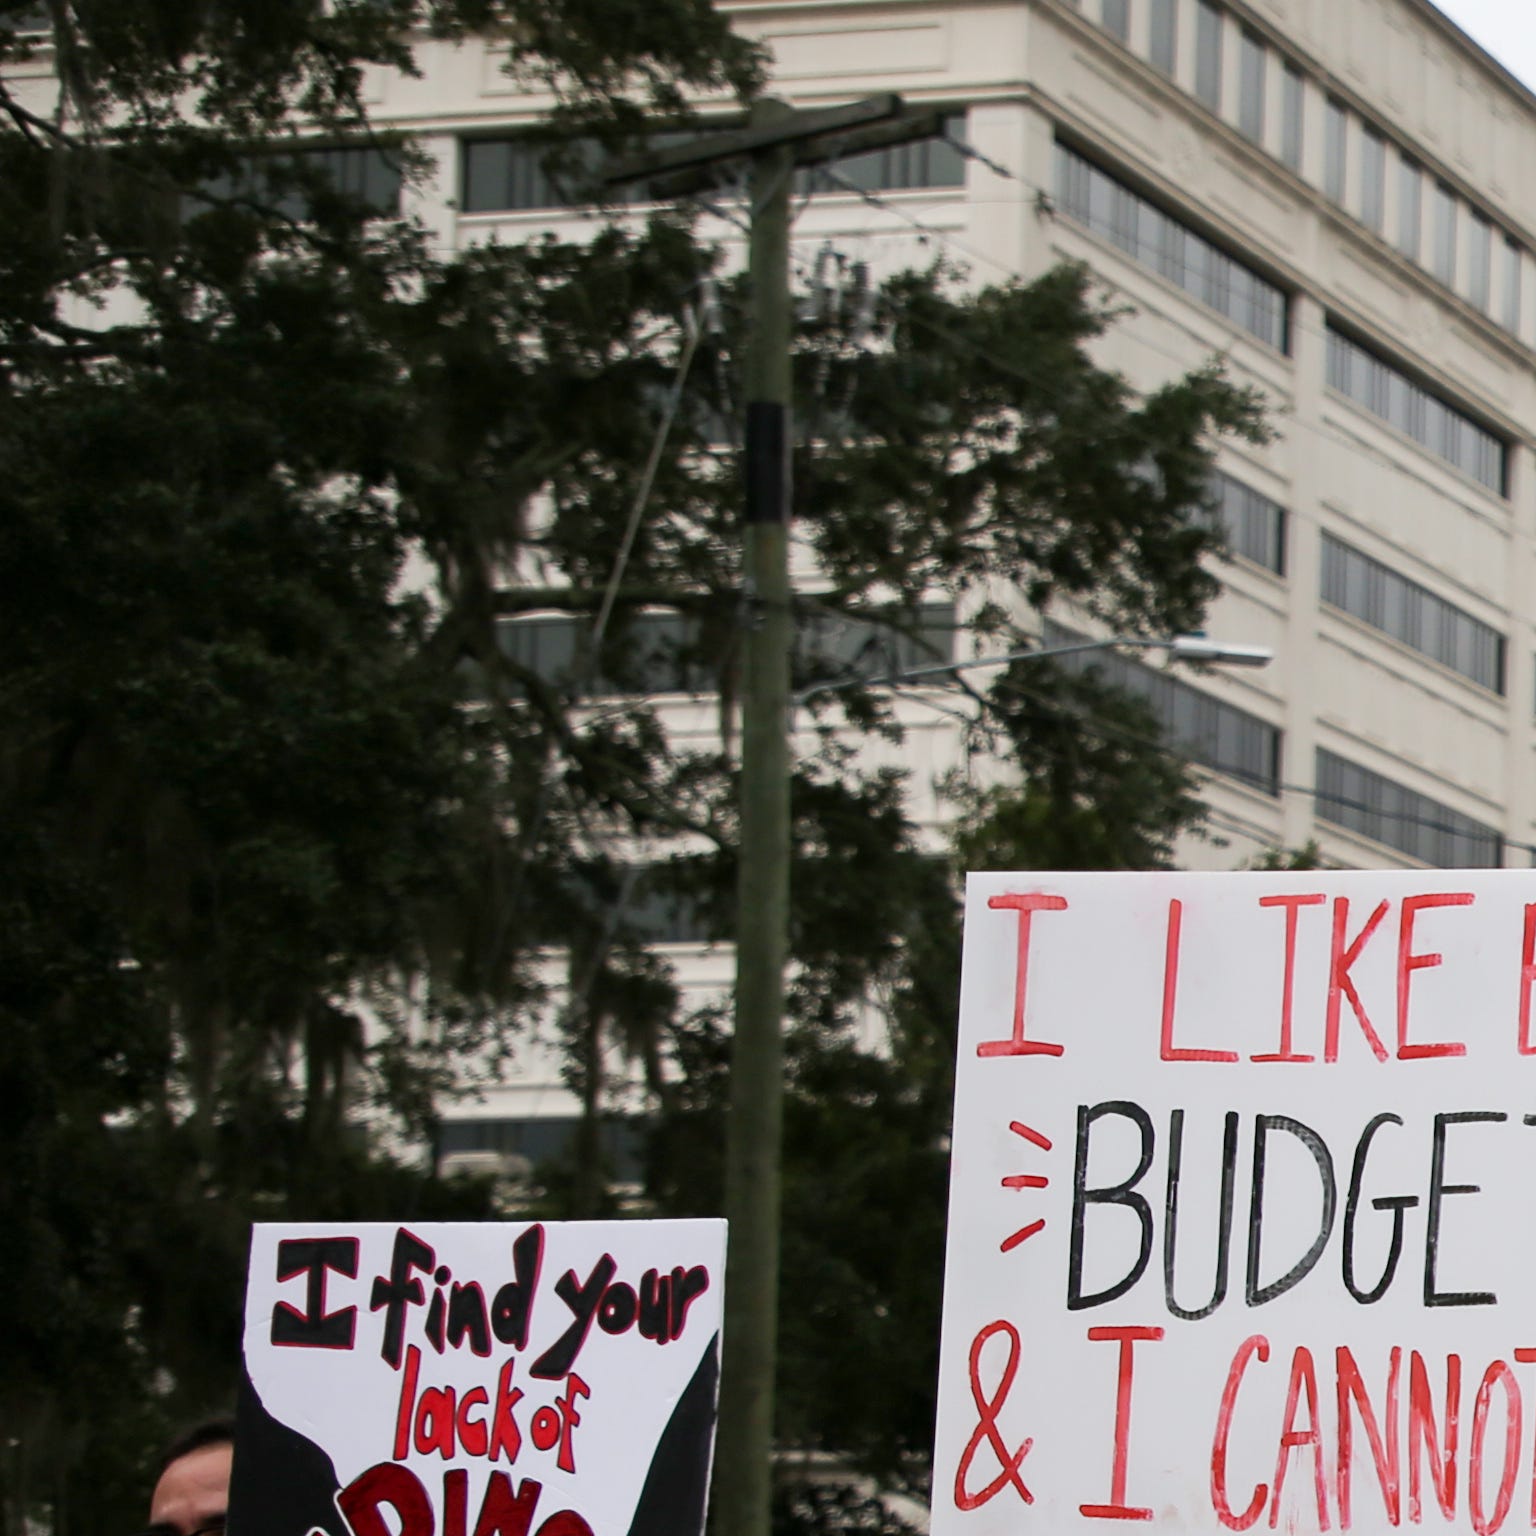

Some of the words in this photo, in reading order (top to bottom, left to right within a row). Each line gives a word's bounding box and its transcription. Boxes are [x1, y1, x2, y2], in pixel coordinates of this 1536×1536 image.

[977, 893, 1067, 1056] I
[1160, 892, 1476, 1063] LIKE
[271, 1237, 360, 1350] I
[370, 1224, 544, 1371] find
[529, 1253, 709, 1380] your
[393, 1343, 524, 1465] lack
[530, 1372, 590, 1474] of
[954, 1320, 1034, 1511] &
[1078, 1326, 1165, 1520] I
